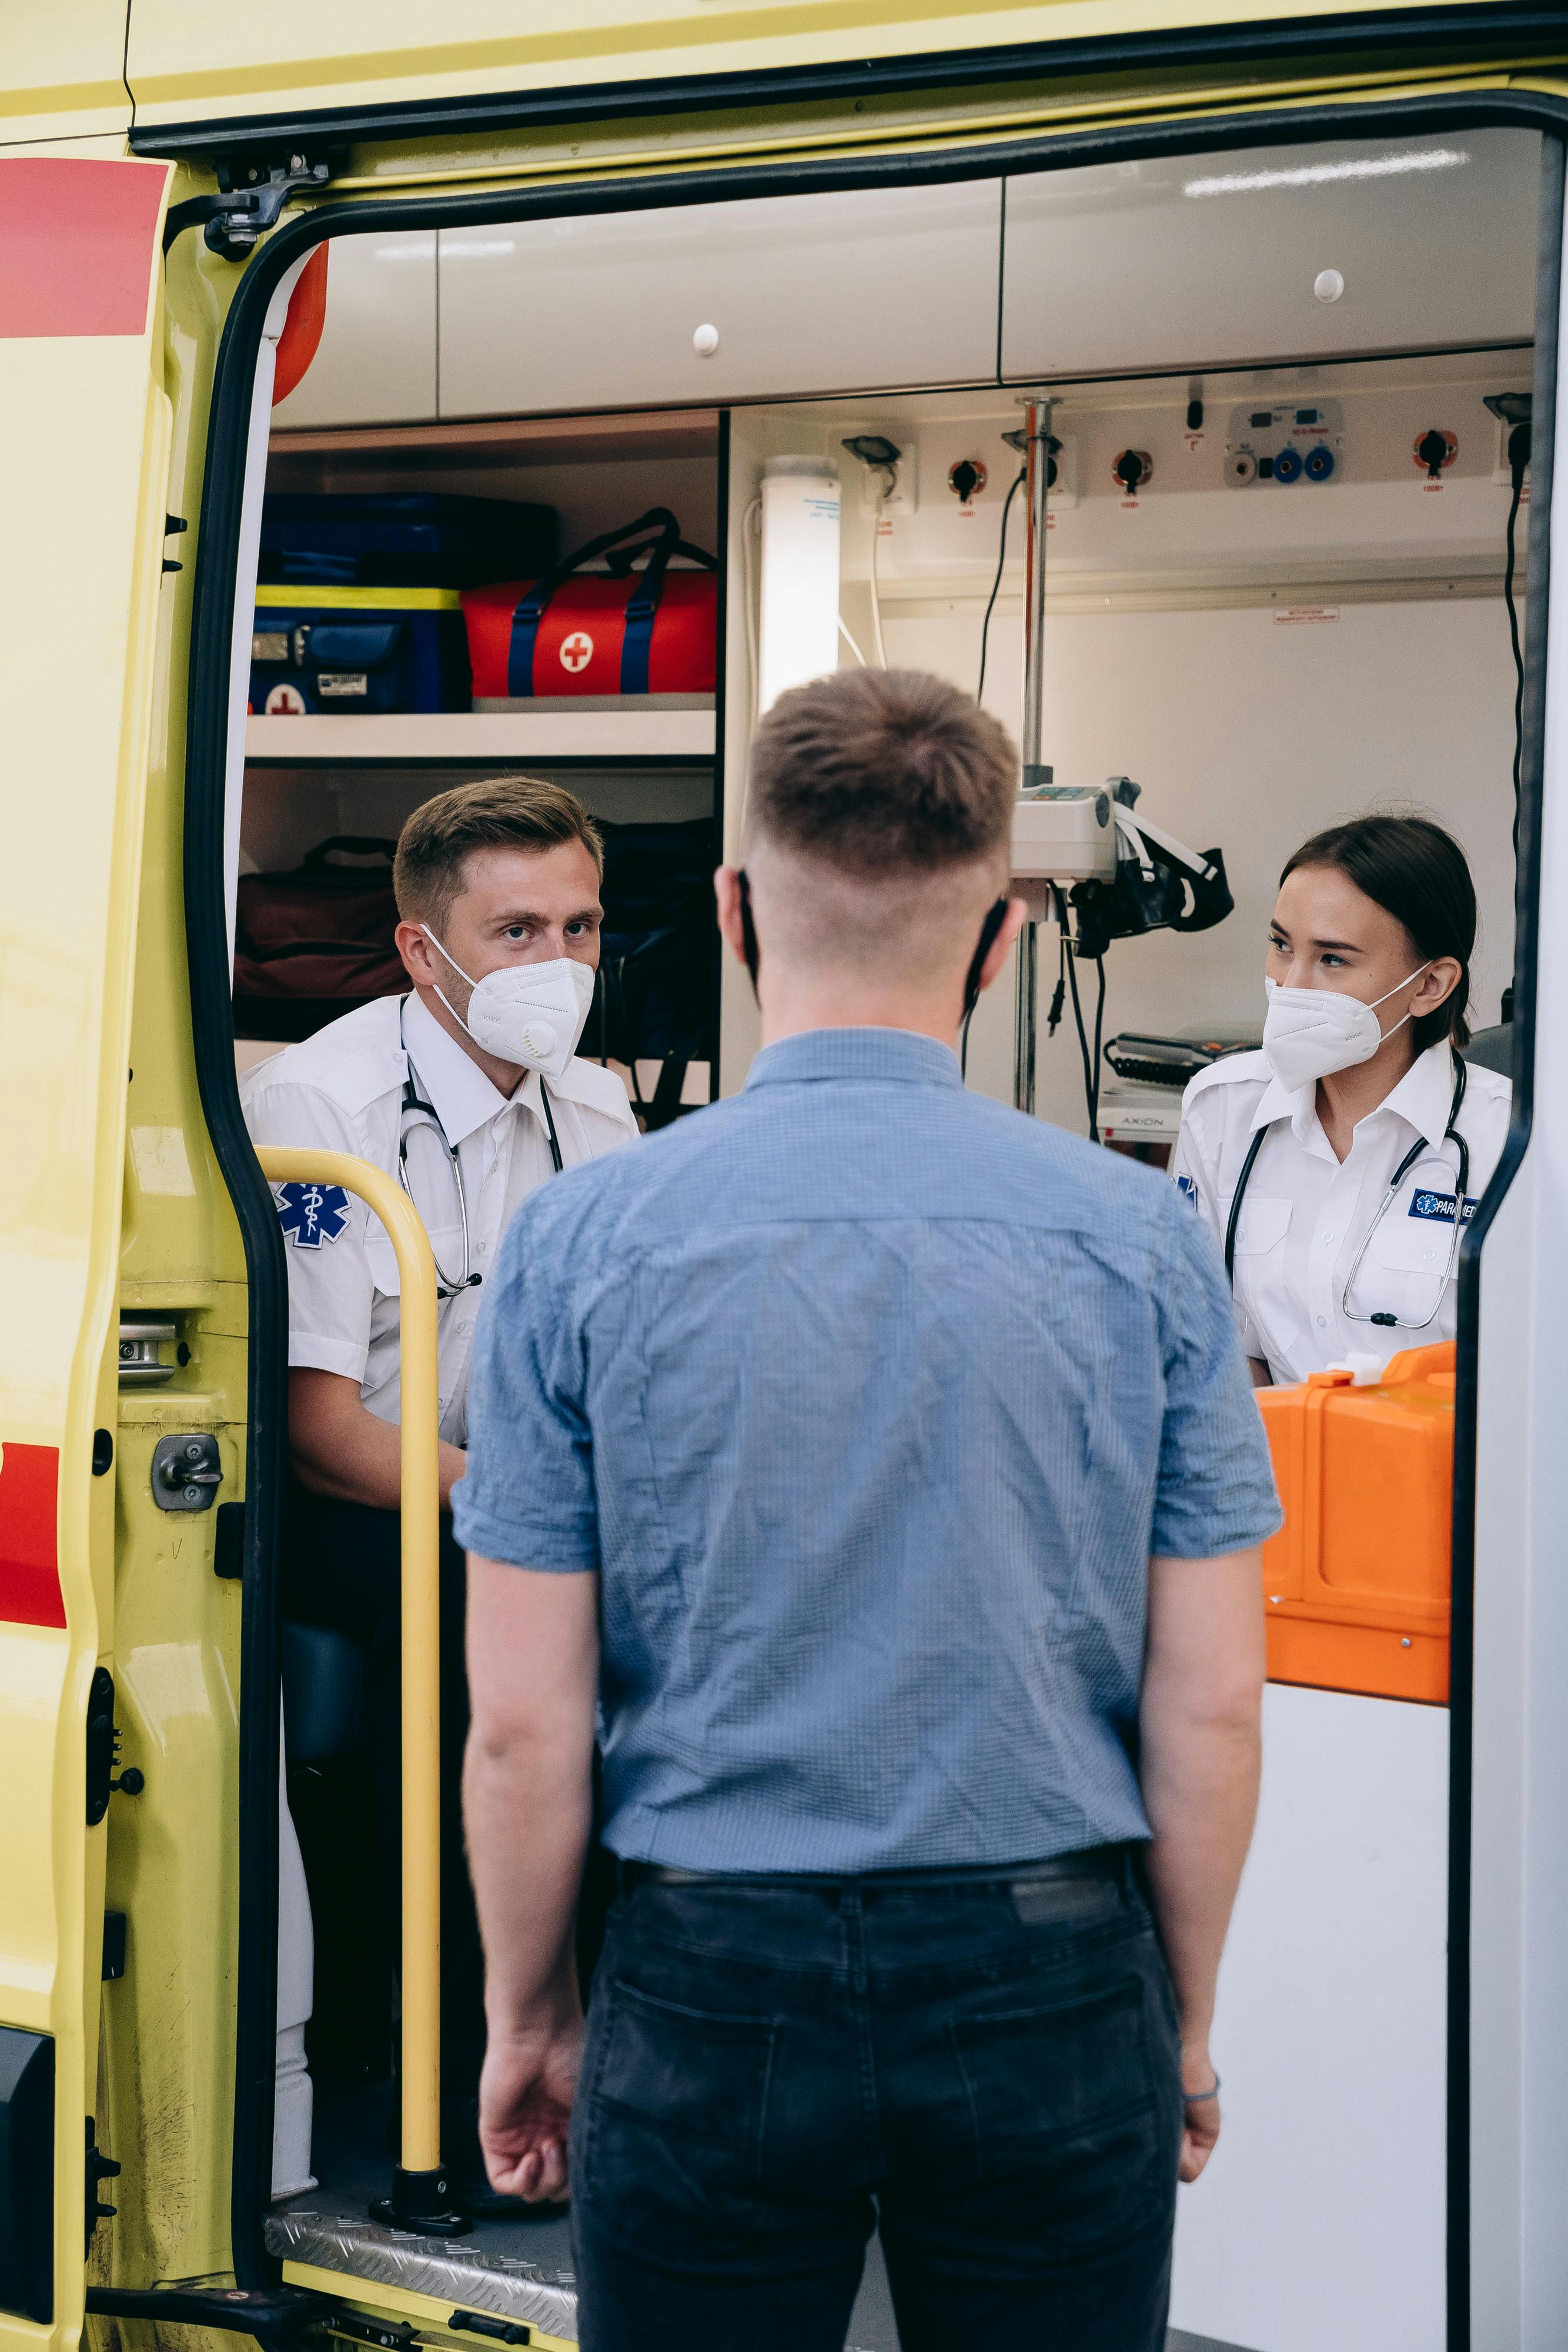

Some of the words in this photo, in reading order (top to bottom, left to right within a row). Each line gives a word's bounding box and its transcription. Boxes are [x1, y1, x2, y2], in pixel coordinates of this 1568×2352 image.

[483, 1015, 501, 1024] KN95
[1345, 1031, 1363, 1041] KN95
[1122, 1118, 1164, 1126] AXION
